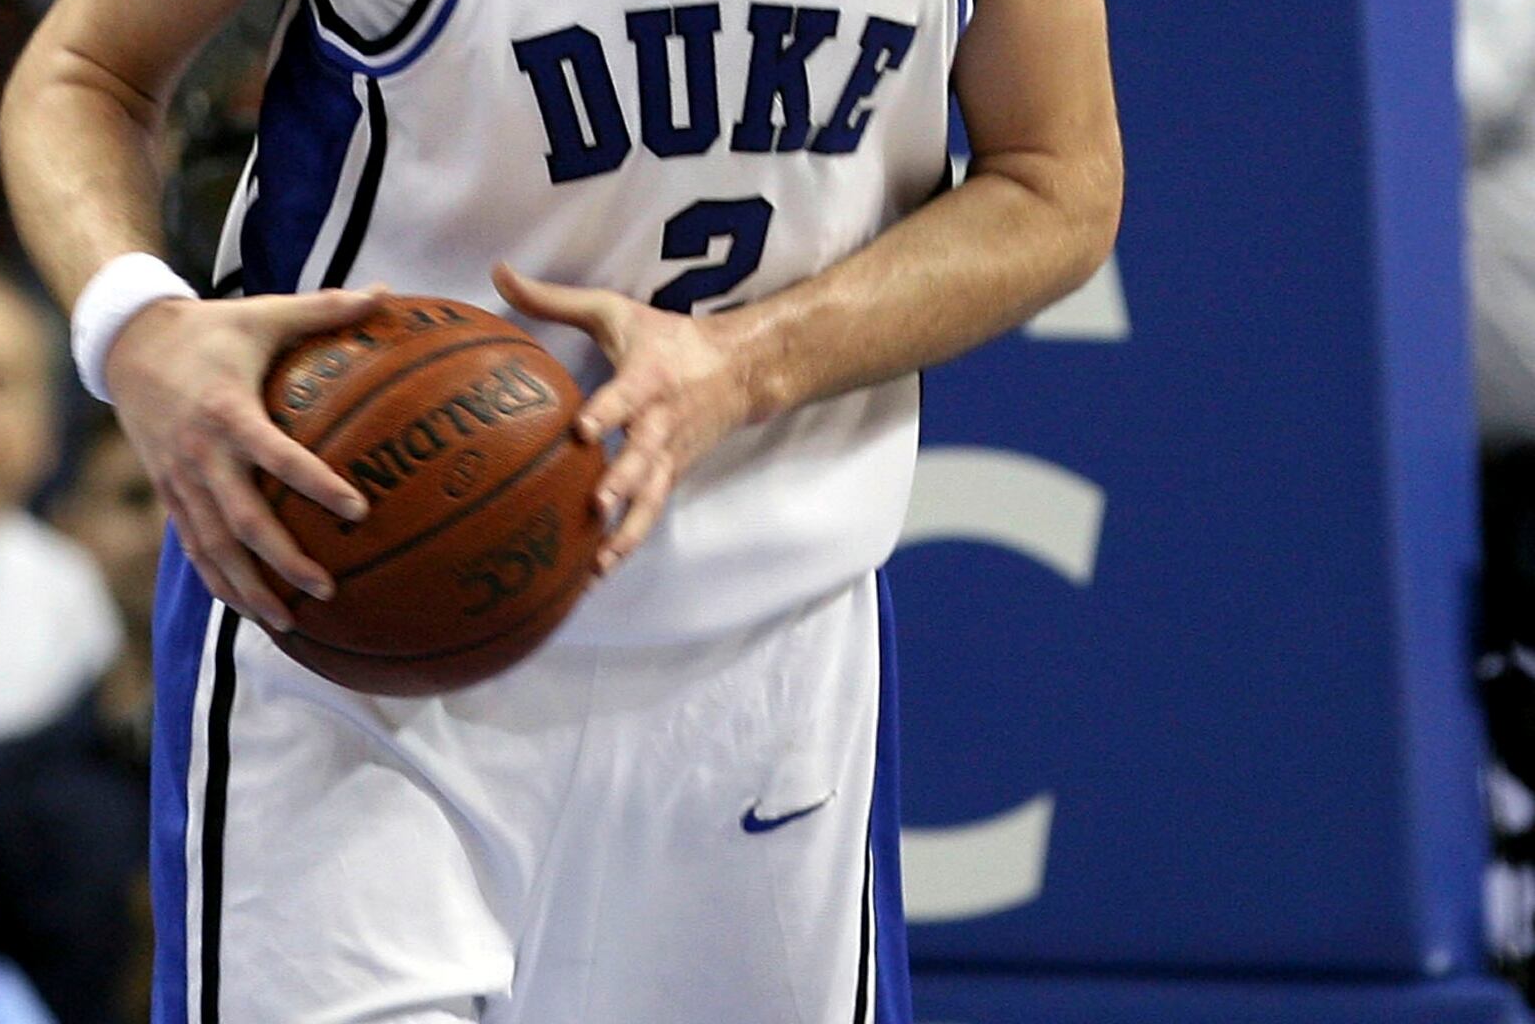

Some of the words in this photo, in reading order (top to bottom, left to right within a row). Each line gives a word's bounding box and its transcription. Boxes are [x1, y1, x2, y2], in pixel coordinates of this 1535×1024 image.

[512, 2, 918, 186] DUKE
[649, 194, 775, 318] 2
[341, 354, 560, 529] SPALDIN
